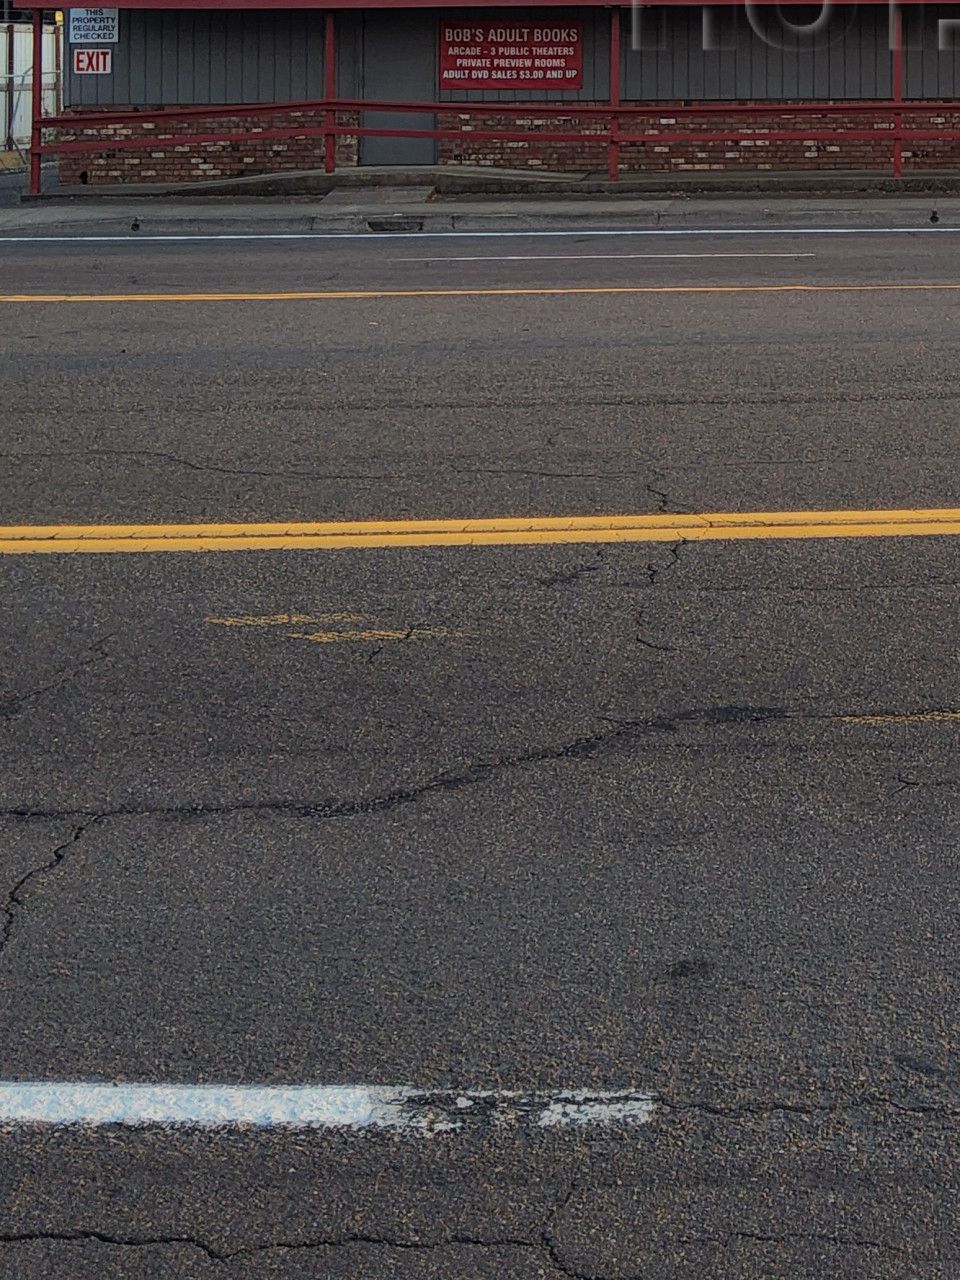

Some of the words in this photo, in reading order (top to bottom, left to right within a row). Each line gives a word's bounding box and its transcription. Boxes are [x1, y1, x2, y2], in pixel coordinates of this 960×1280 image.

[85, 8, 104, 16] THIS
[72, 16, 116, 24] PROPERTY
[72, 24, 115, 32] REGULARLY
[73, 32, 114, 40] CHECKED
[445, 28, 484, 42] BOB'S
[487, 28, 530, 42] ADULT
[534, 28, 578, 42] BOOKS
[448, 46, 481, 56] ARCADE
[490, 46, 497, 56] 3
[498, 46, 530, 56] PUBLIC
[532, 46, 574, 56] THEATERS
[76, 51, 110, 72] EXIT
[456, 58, 491, 68] PRIVATE
[493, 58, 532, 68] PREVIEW
[534, 58, 566, 68] ROOMS
[443, 70, 469, 79] ADULT
[471, 70, 489, 79] DVD
[491, 70, 517, 79] SALES
[519, 70, 544, 79] $3.00
[546, 70, 563, 79] AND
[565, 70, 577, 79] UP
